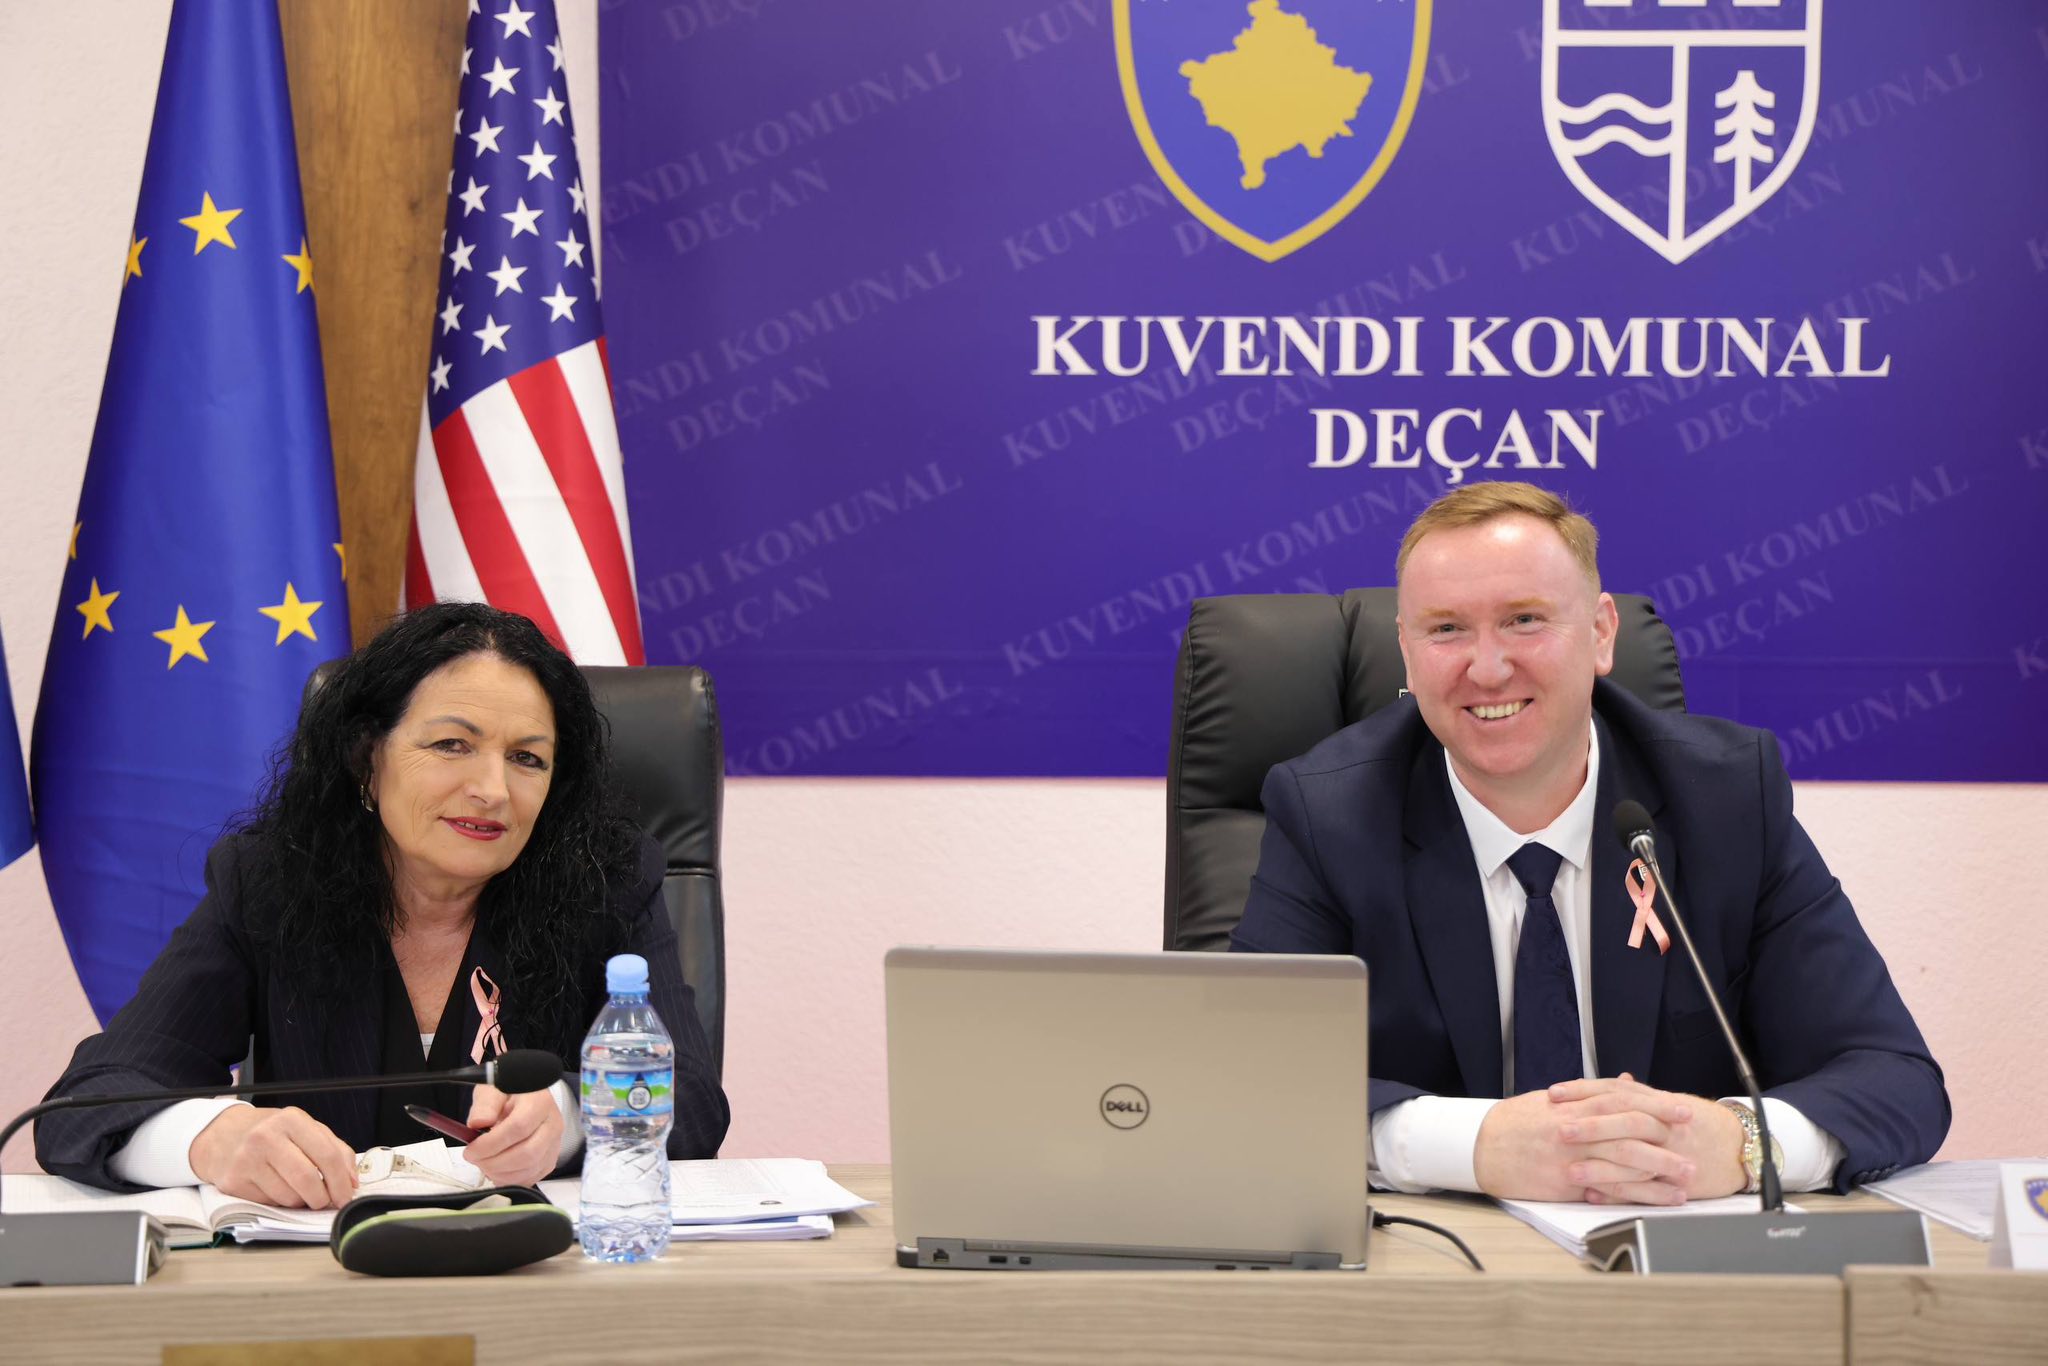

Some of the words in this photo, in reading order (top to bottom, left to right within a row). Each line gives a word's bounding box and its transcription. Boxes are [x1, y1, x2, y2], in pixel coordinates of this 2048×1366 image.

[716, 50, 963, 174] KOMUNAL
[665, 159, 830, 257] DEÇAN
[1002, 177, 1169, 272] KUVEN
[719, 250, 963, 373] KOMUNAL
[1031, 315, 1424, 377] KUVENDI
[1445, 316, 1891, 378] KOMUNAL
[667, 358, 831, 453] DEÇAN
[1308, 406, 1604, 485] DEÇAN
[720, 462, 964, 584] KOMUNAL
[1724, 464, 1970, 586] KOMUNAL
[669, 567, 832, 663] DEÇAN
[1003, 563, 1215, 677] KUVENDI
[1106, 1101, 1144, 1112] DELL
